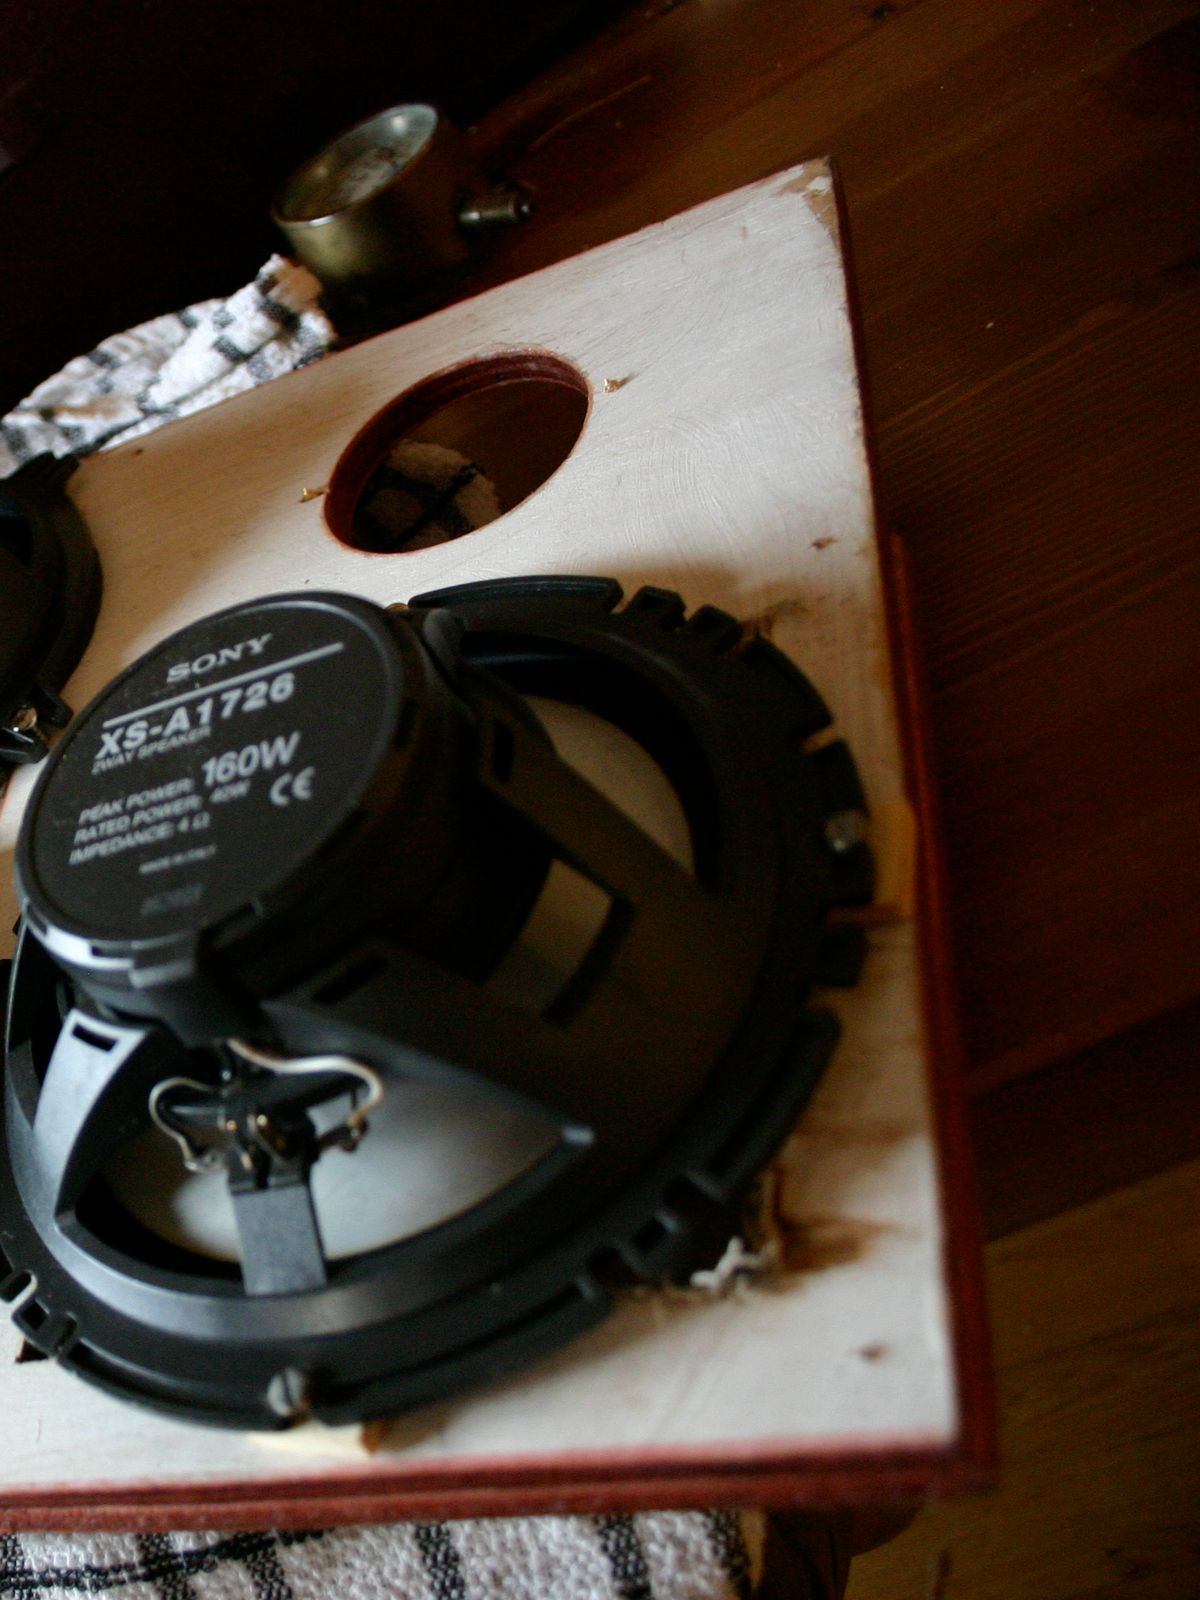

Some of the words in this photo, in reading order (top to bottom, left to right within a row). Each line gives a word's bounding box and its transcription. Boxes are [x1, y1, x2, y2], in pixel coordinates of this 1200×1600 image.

[166, 634, 270, 683] SONY
[94, 673, 294, 764] XS-A1726
[203, 732, 299, 786] 160W
